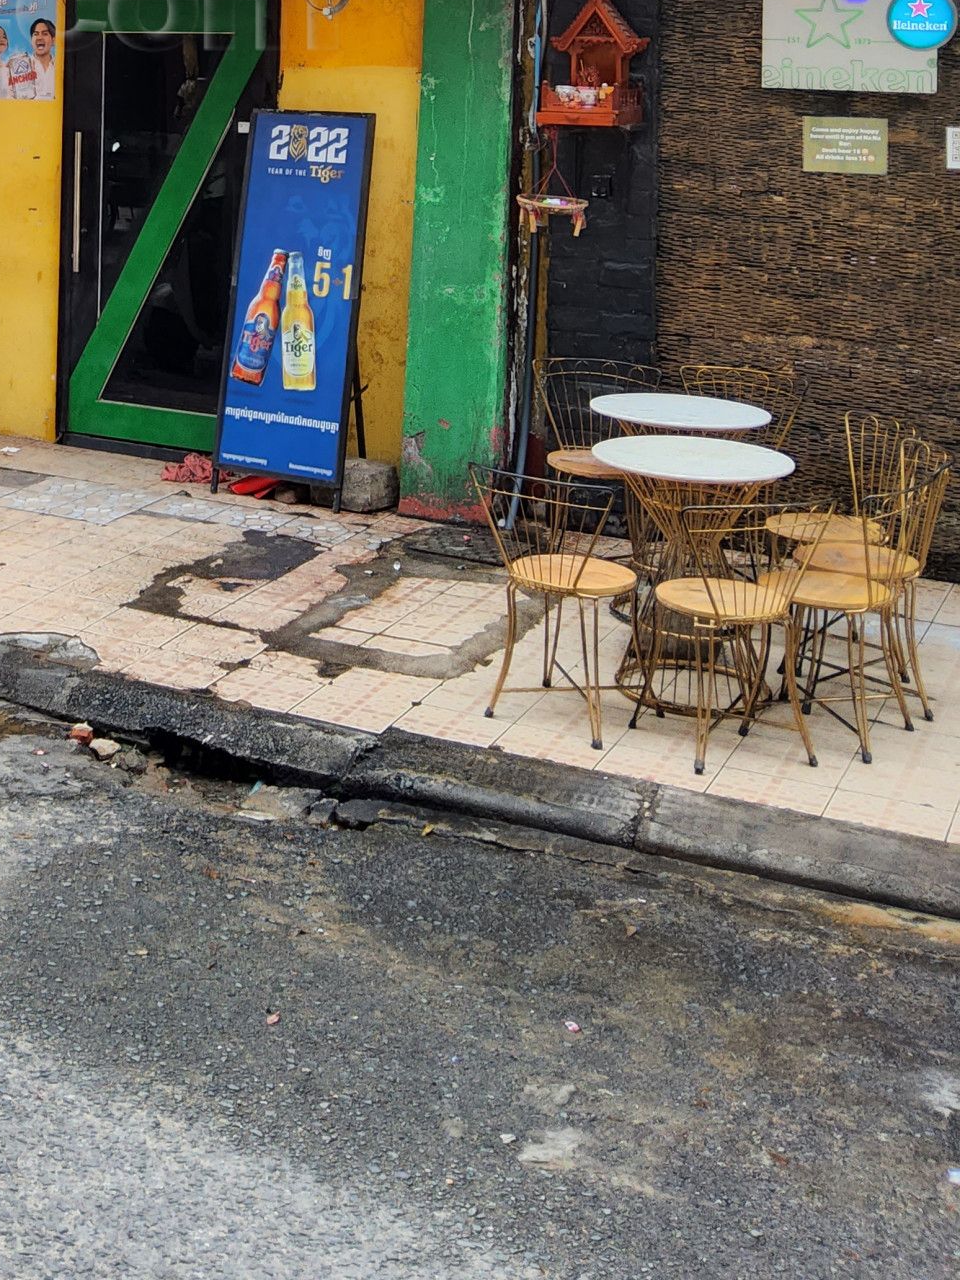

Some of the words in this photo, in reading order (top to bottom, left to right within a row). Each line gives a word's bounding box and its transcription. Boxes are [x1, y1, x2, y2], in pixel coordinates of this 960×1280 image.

[892, 20, 948, 31] Heineken
[8, 70, 38, 87] ANCHOR
[762, 57, 935, 93] eineken
[309, 164, 344, 184] Tiger
[284, 339, 313, 358] Tiger
